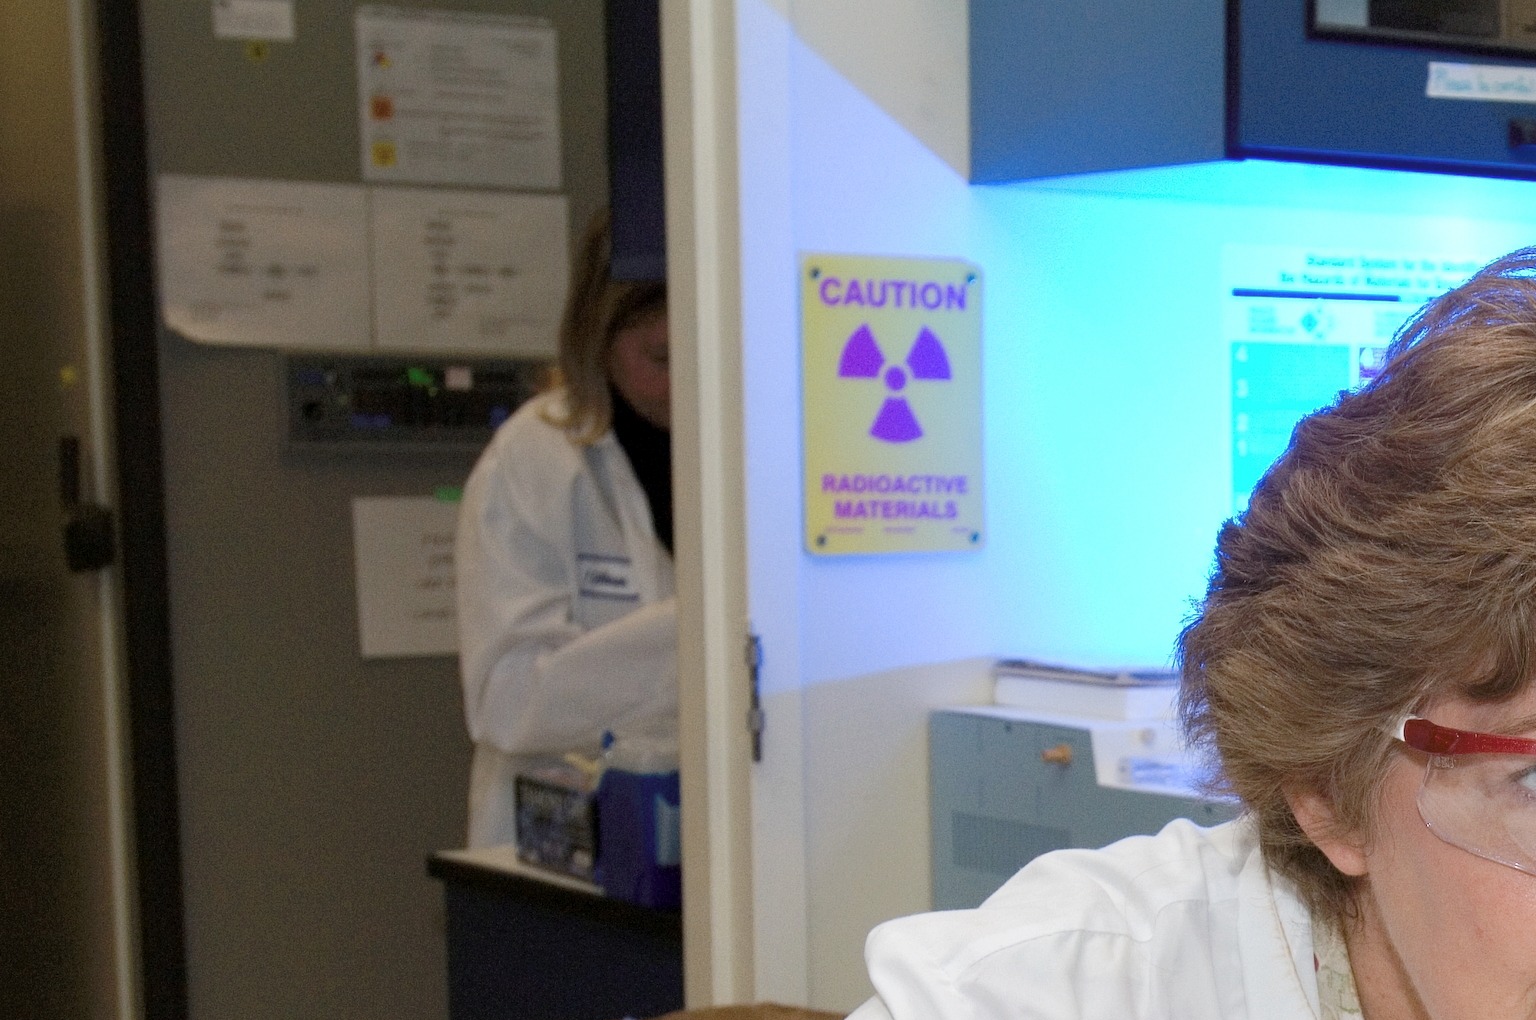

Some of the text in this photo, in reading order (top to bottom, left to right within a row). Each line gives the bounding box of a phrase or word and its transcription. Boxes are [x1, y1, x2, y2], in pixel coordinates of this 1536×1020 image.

[819, 277, 968, 311] CAUTION
[822, 474, 970, 495] RADIOACTIVE
[834, 500, 959, 520] MATERIALS
